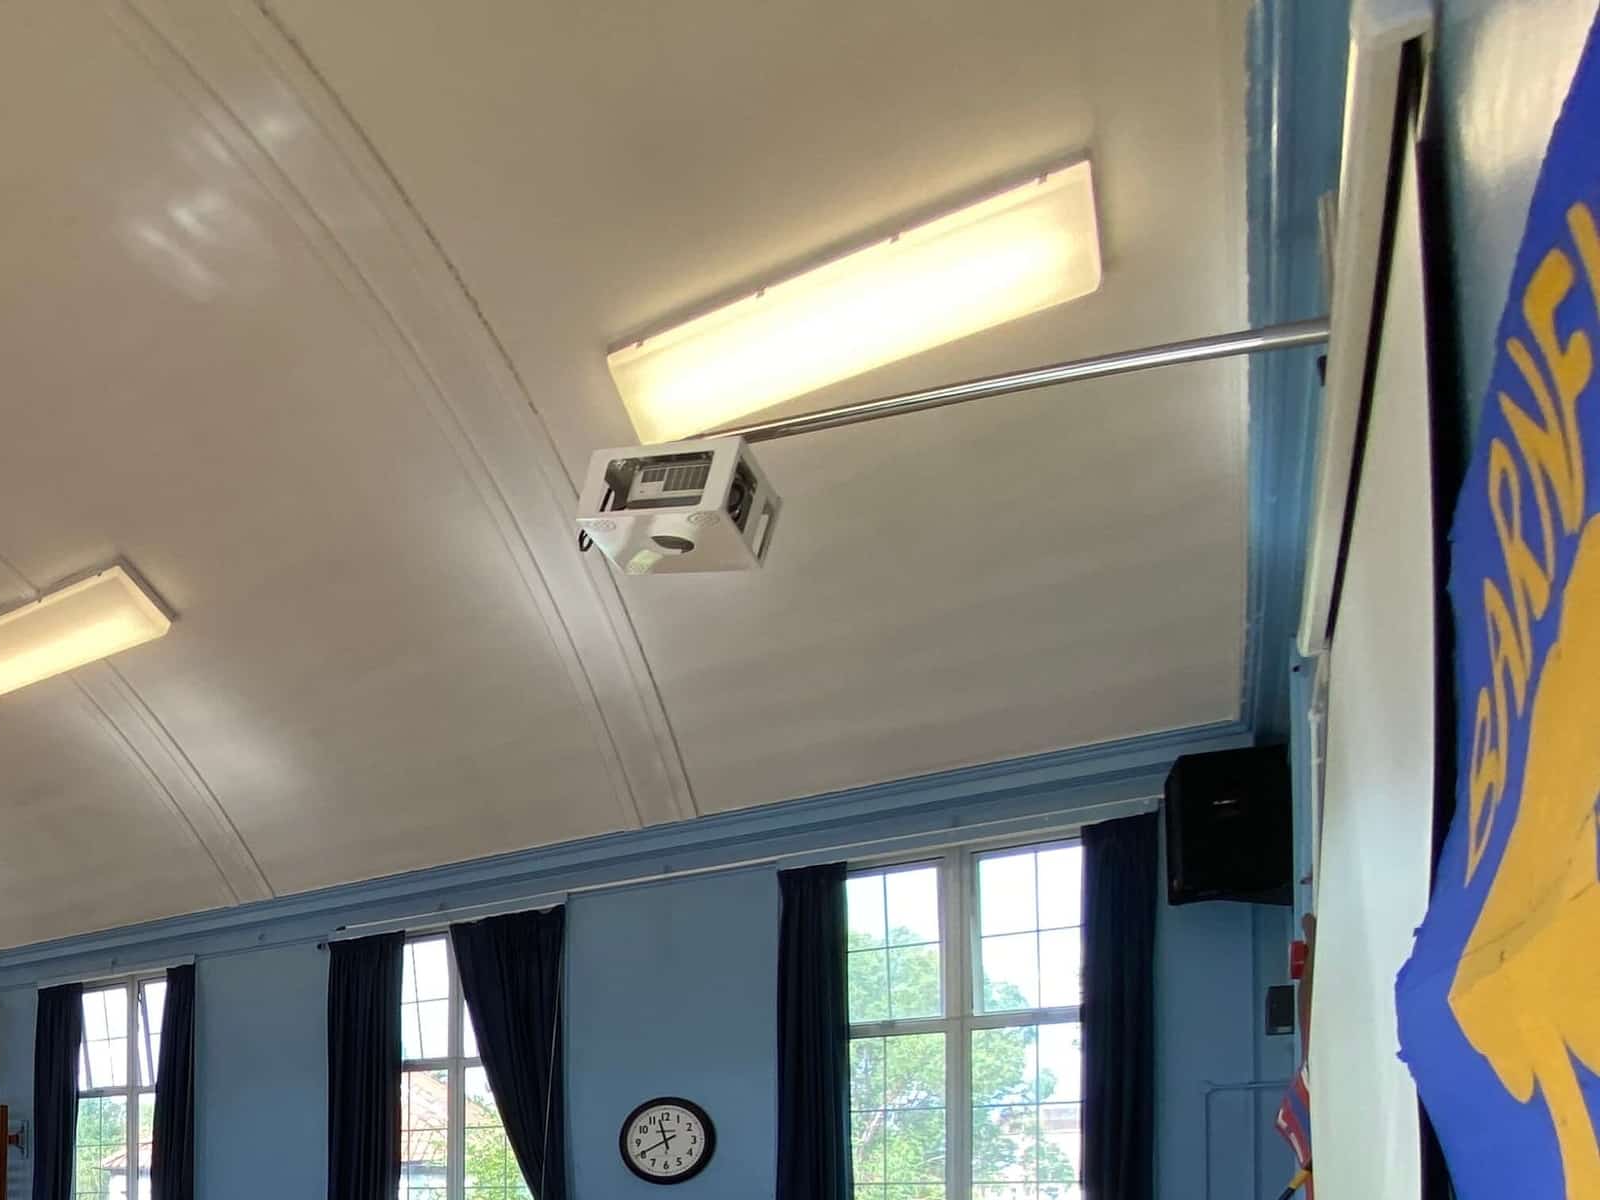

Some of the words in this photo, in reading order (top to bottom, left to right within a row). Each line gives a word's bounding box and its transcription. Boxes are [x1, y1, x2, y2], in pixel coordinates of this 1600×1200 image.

[649, 1116, 655, 1125] 11
[661, 1112, 670, 1121] 12
[639, 1125, 649, 1134] 10
[686, 1122, 693, 1131] 2
[635, 1138, 642, 1147] 9
[691, 1135, 697, 1144] 3
[640, 1151, 647, 1159] 8
[686, 1148, 693, 1157] 4
[649, 1158, 656, 1167] 7
[663, 1160, 669, 1170] 6
[676, 1157, 682, 1166] 5
